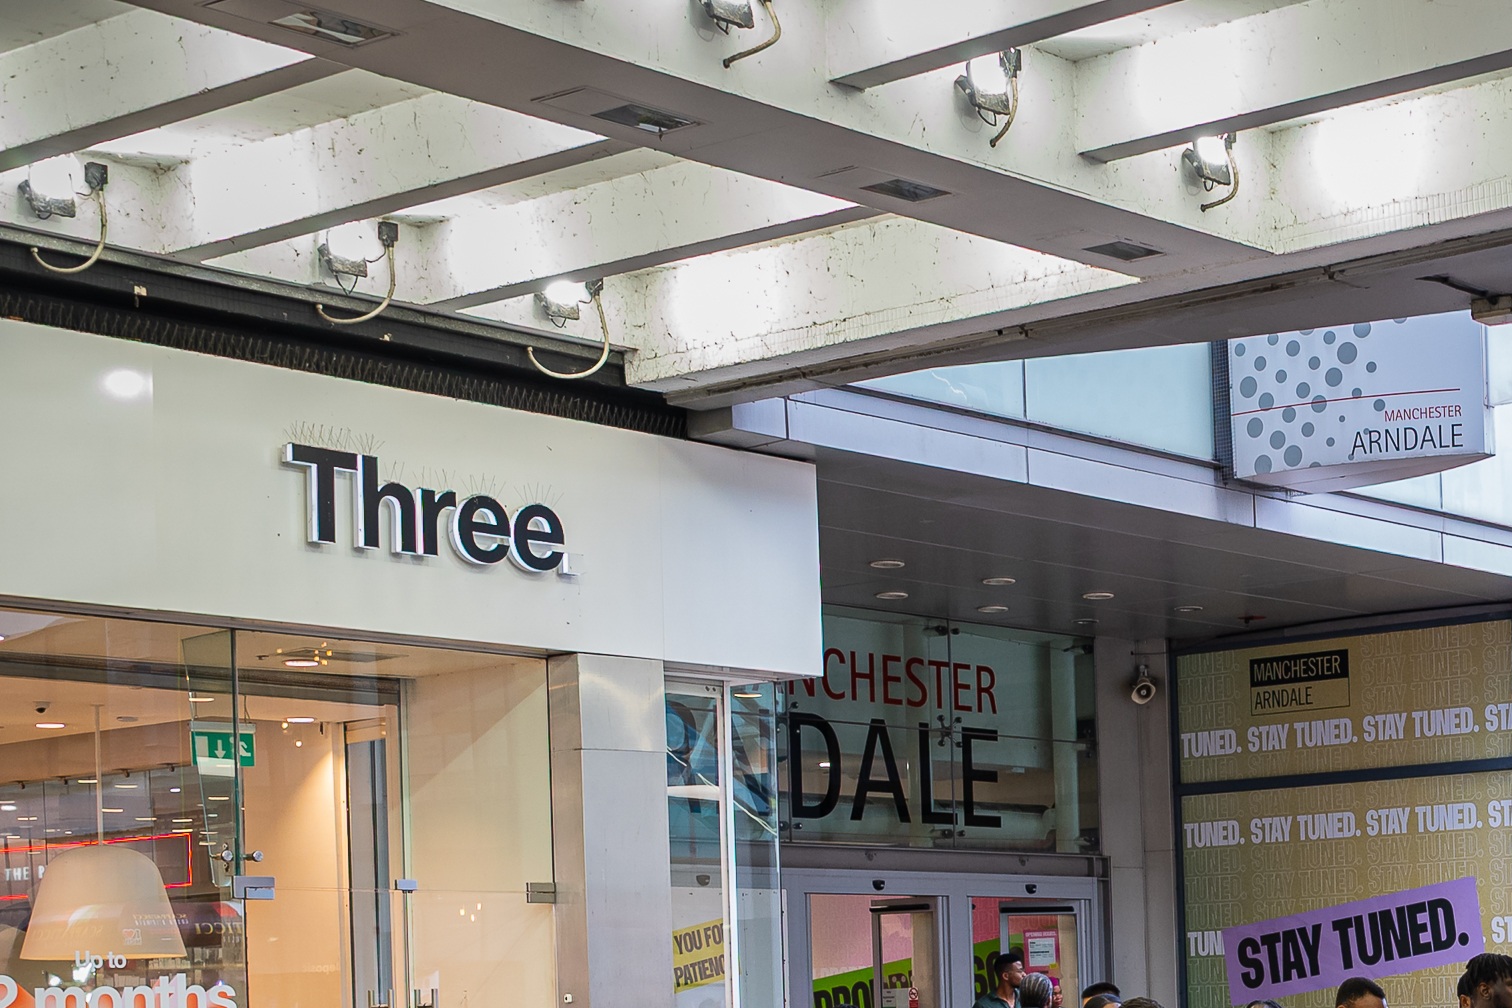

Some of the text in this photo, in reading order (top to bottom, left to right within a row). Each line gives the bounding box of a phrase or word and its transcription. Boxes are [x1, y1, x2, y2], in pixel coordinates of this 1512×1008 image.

[1384, 403, 1462, 422] MANCHESTER
[1351, 423, 1464, 454] ARNDALE
[282, 442, 565, 572] Three
[1253, 655, 1341, 682] MANCHESTER
[1254, 686, 1313, 710] ARNDALE
[1181, 730, 1242, 758] TUNED.
[1247, 723, 1288, 752] STAY
[1294, 718, 1357, 748] TUNED.
[1363, 713, 1406, 742] STAY
[1412, 706, 1479, 737] TUNED.
[1184, 820, 1245, 848] TUNED.
[1251, 816, 1293, 845] STAY
[1298, 811, 1361, 840] TUNED.
[1366, 807, 1410, 835] STAY
[1415, 801, 1482, 830] TUNED.
[673, 929, 703, 955] YOU
[1236, 898, 1470, 989] STAY TUNED.
[75, 950, 127, 970] Up to
